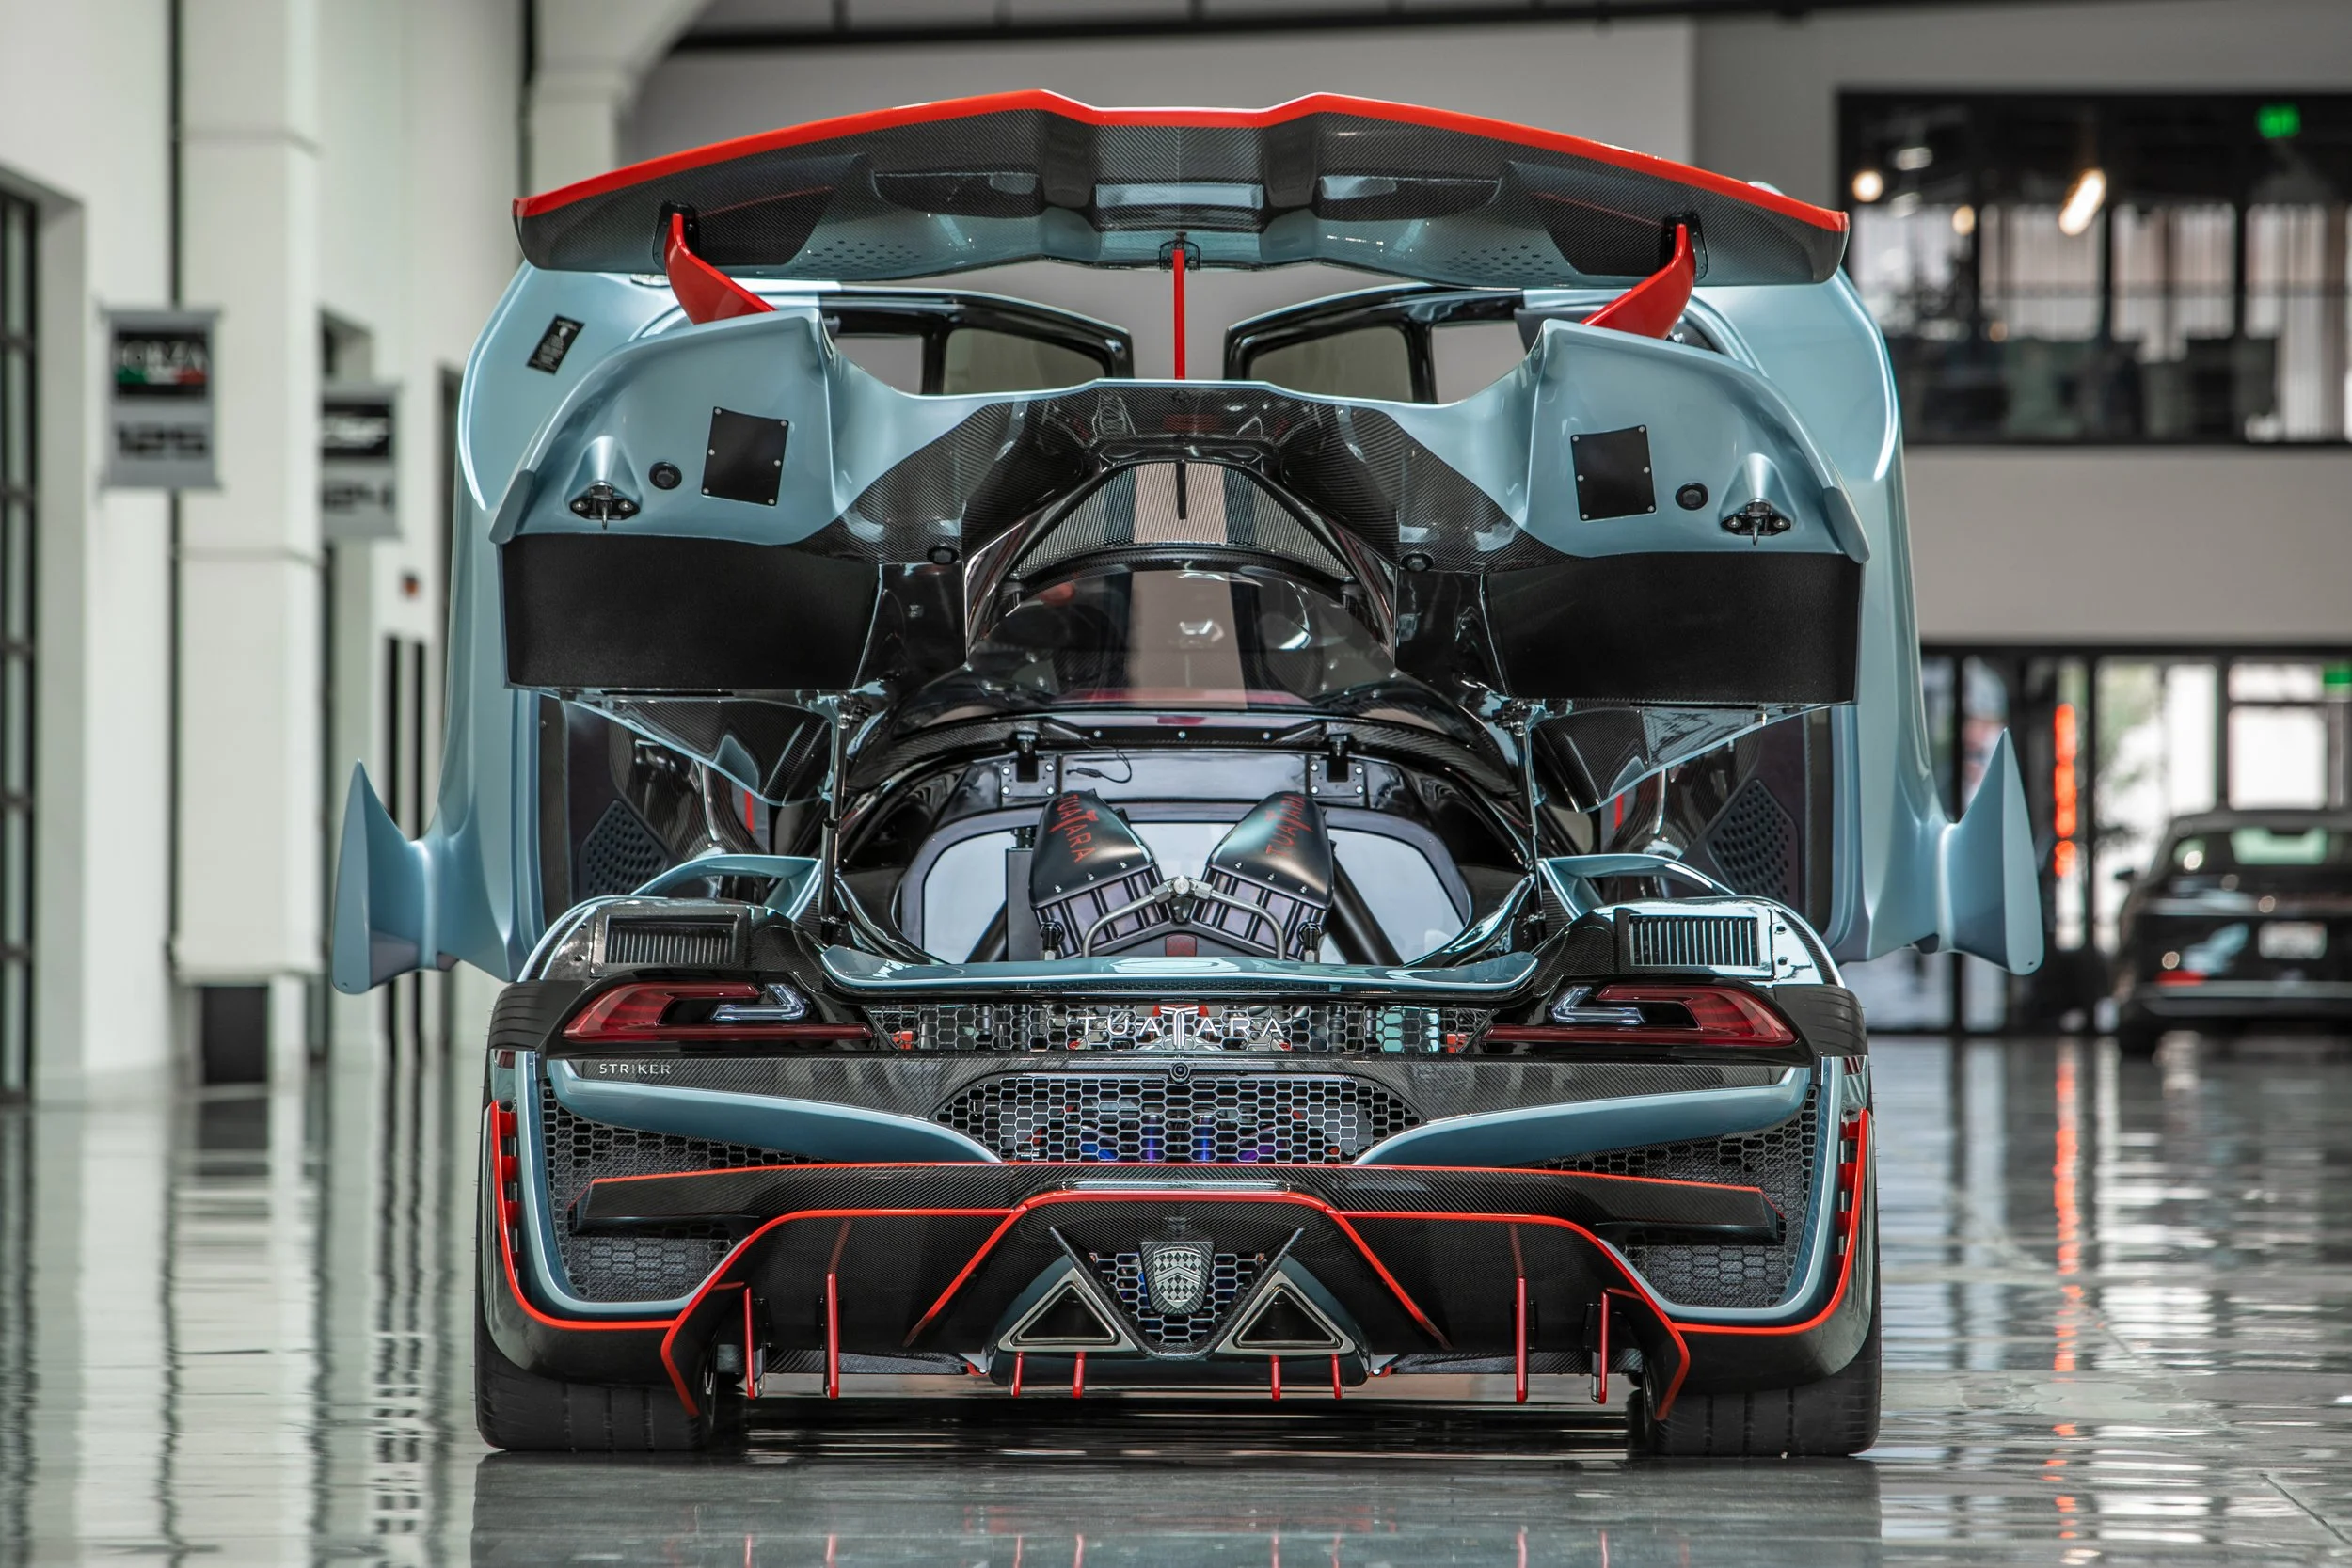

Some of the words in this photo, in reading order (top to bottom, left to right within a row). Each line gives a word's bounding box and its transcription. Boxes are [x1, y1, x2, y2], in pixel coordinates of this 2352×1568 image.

[1049, 793, 1099, 863] TUATARA
[1264, 795, 1314, 858] TUATARA
[1078, 1005, 1285, 1049] TUATARA
[599, 1063, 671, 1075] STRIKER
